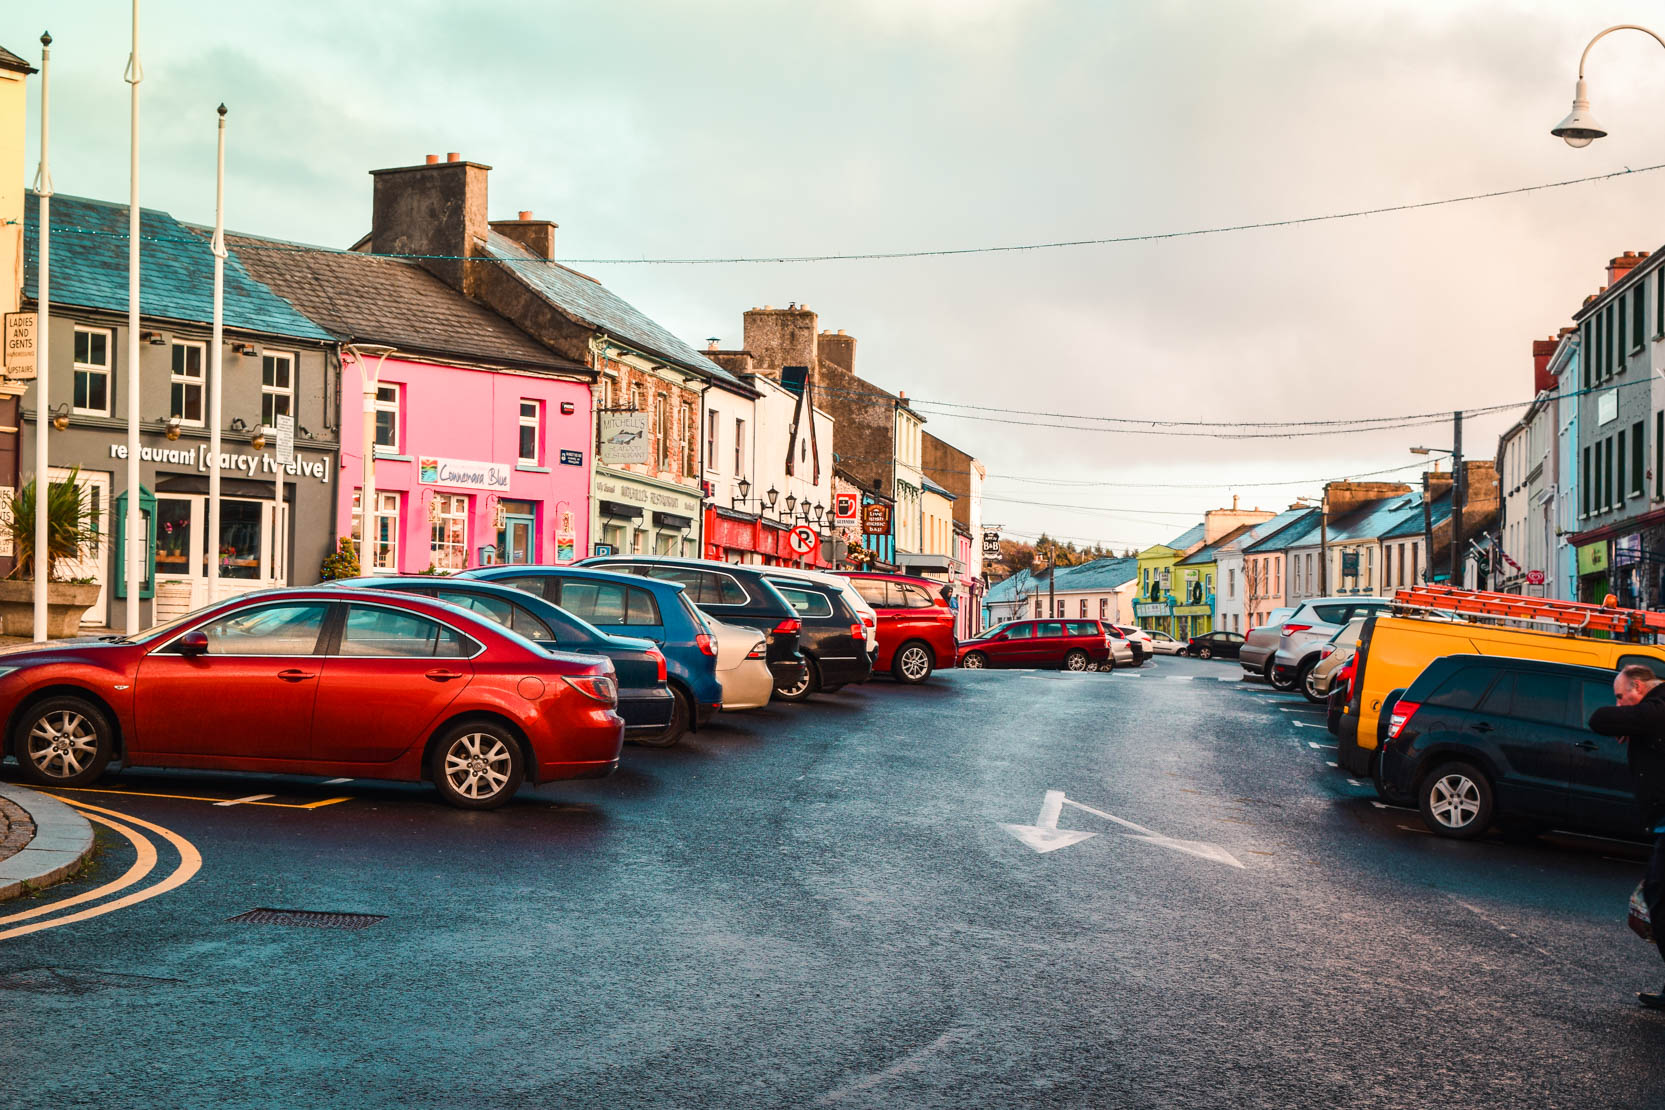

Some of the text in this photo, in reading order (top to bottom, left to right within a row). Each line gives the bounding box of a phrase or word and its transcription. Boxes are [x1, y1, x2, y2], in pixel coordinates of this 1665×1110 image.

[10, 317, 33, 327] LADIES
[13, 328, 29, 338] AND
[9, 338, 33, 349] GENTS
[7, 365, 33, 374] UPSTAIRS
[603, 418, 645, 430] MITCHELL'S
[111, 443, 195, 465] retaurant
[440, 464, 508, 486] Connemara Blue
